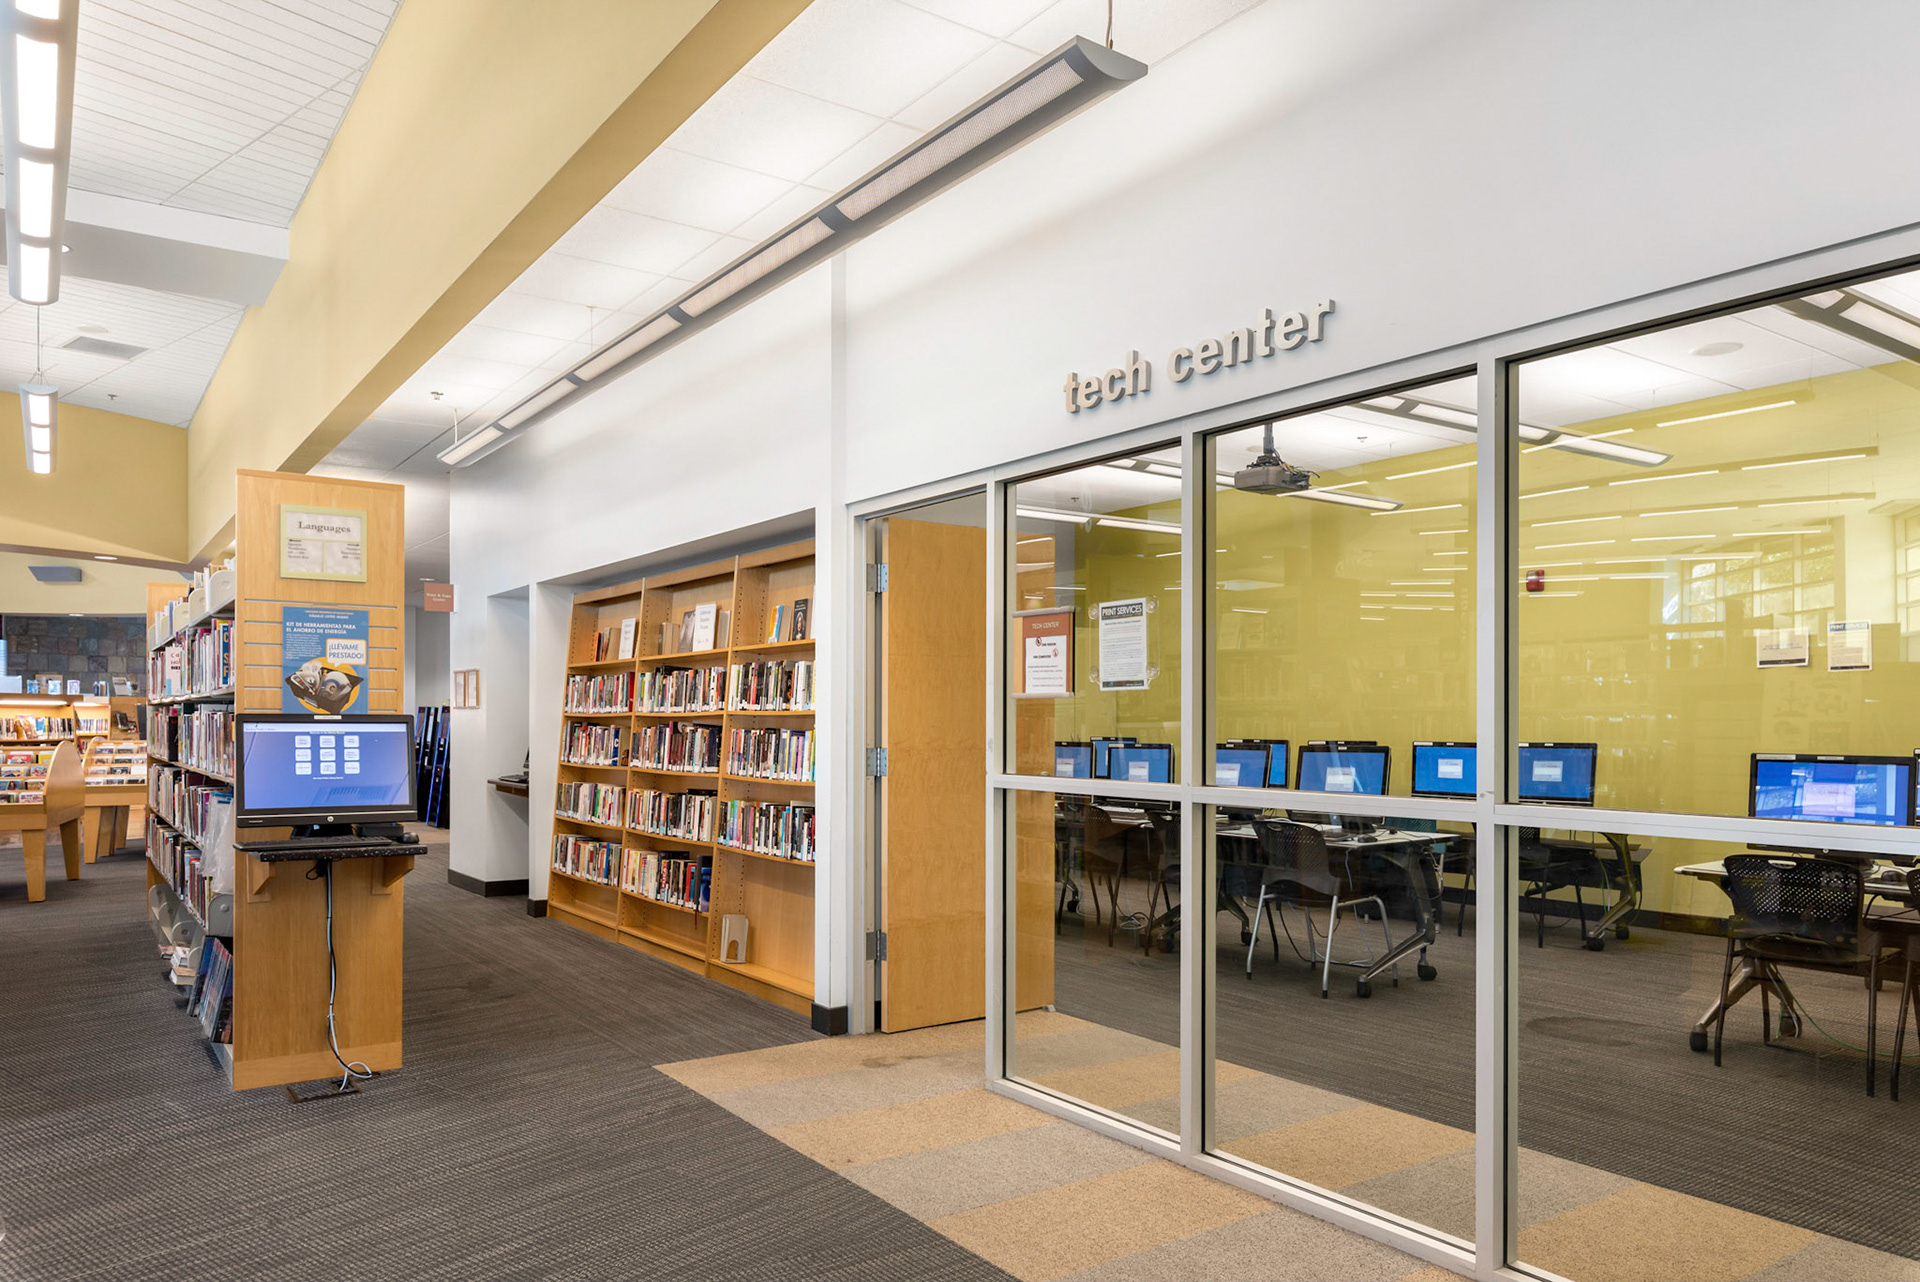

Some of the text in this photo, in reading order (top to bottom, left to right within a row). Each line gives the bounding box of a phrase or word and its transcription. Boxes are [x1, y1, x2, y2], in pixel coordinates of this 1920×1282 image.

[1063, 299, 1335, 413] tech center
[298, 521, 351, 533] Languages
[1102, 604, 1142, 616] PRINT SERVICES
[329, 652, 365, 660] PRESTADO!
